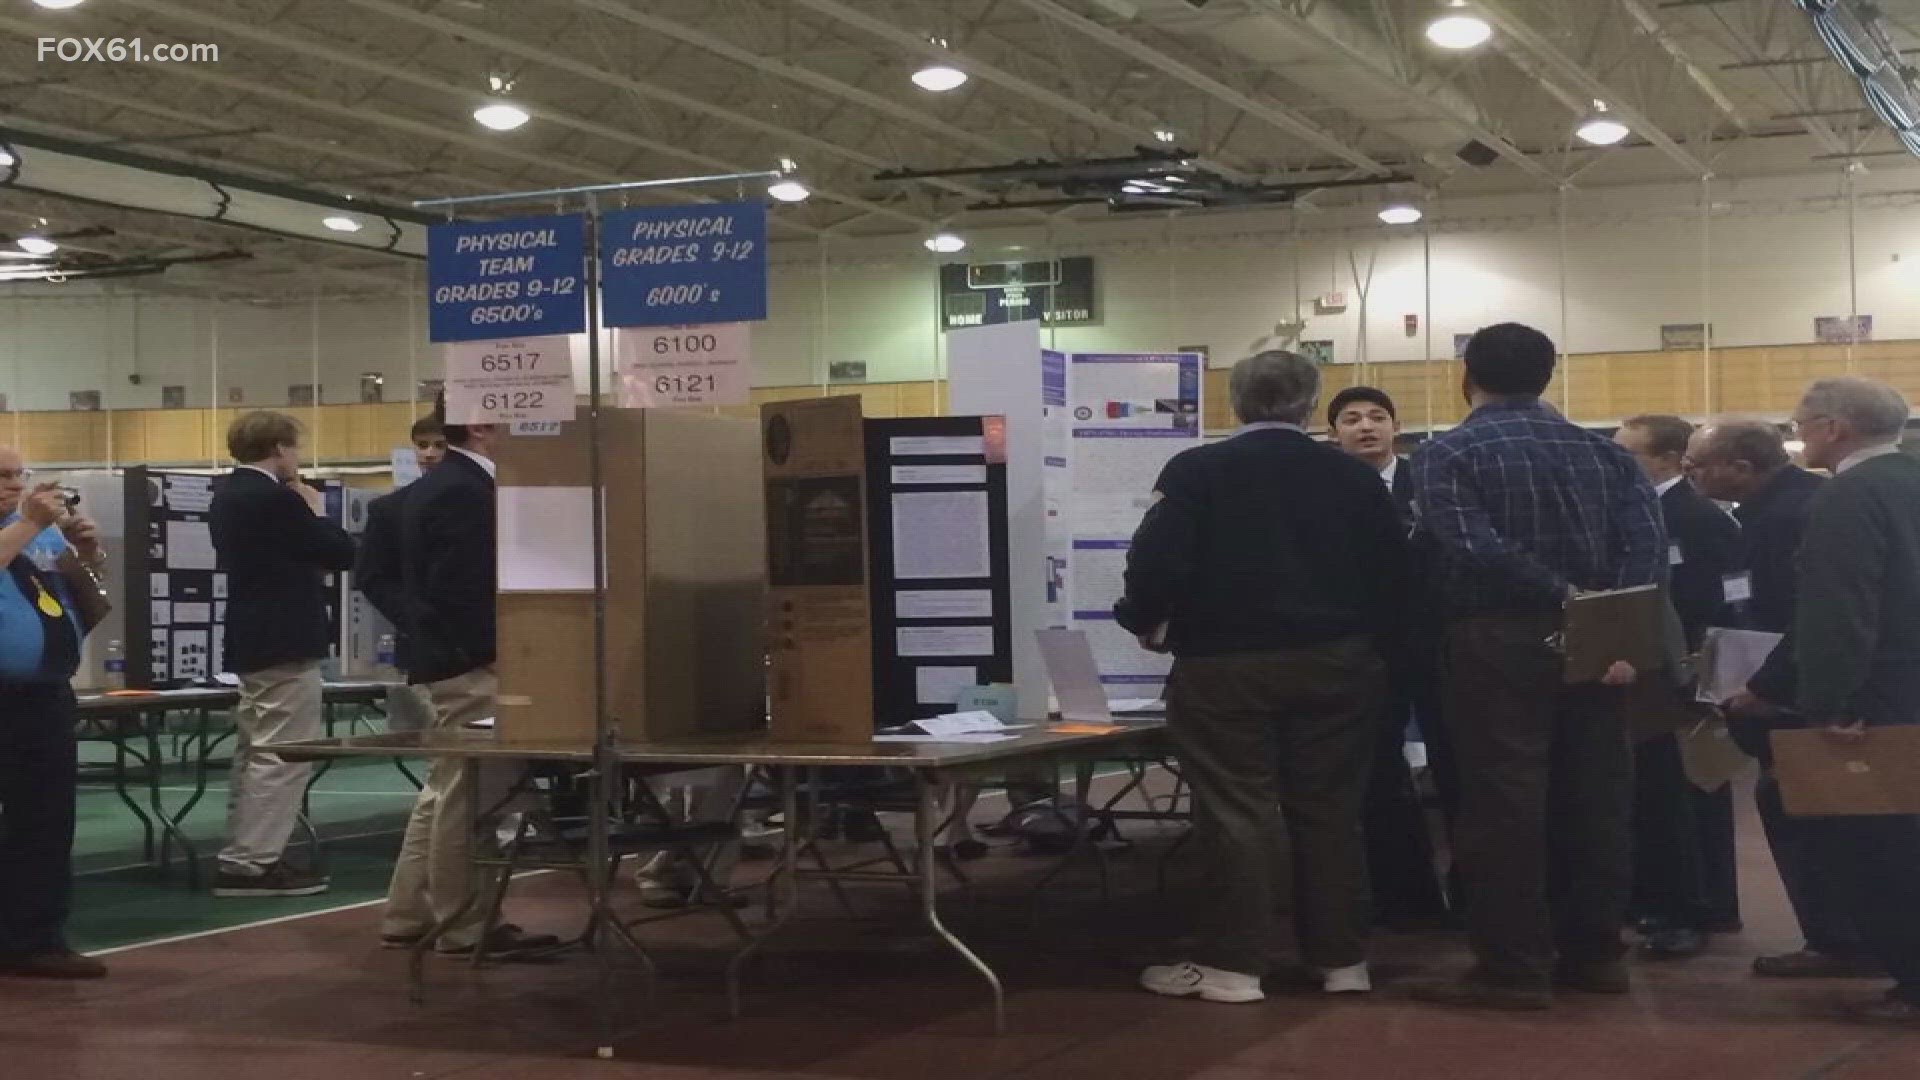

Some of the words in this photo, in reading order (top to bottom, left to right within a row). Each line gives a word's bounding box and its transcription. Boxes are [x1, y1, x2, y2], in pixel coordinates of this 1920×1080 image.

[631, 215, 734, 241] PHYSICAL
[455, 229, 557, 253] PHYSICAL
[612, 243, 699, 268] GRADES
[712, 240, 754, 262] 9-12
[478, 255, 535, 278] TEAM
[434, 282, 520, 304] GRADES
[526, 276, 576, 297] 9-12
[645, 282, 721, 307] 6000's
[470, 303, 543, 325] 6500's
[653, 333, 717, 355] 6100
[481, 352, 541, 373] 6517
[655, 374, 716, 395] 6121
[481, 390, 544, 411] 6122
